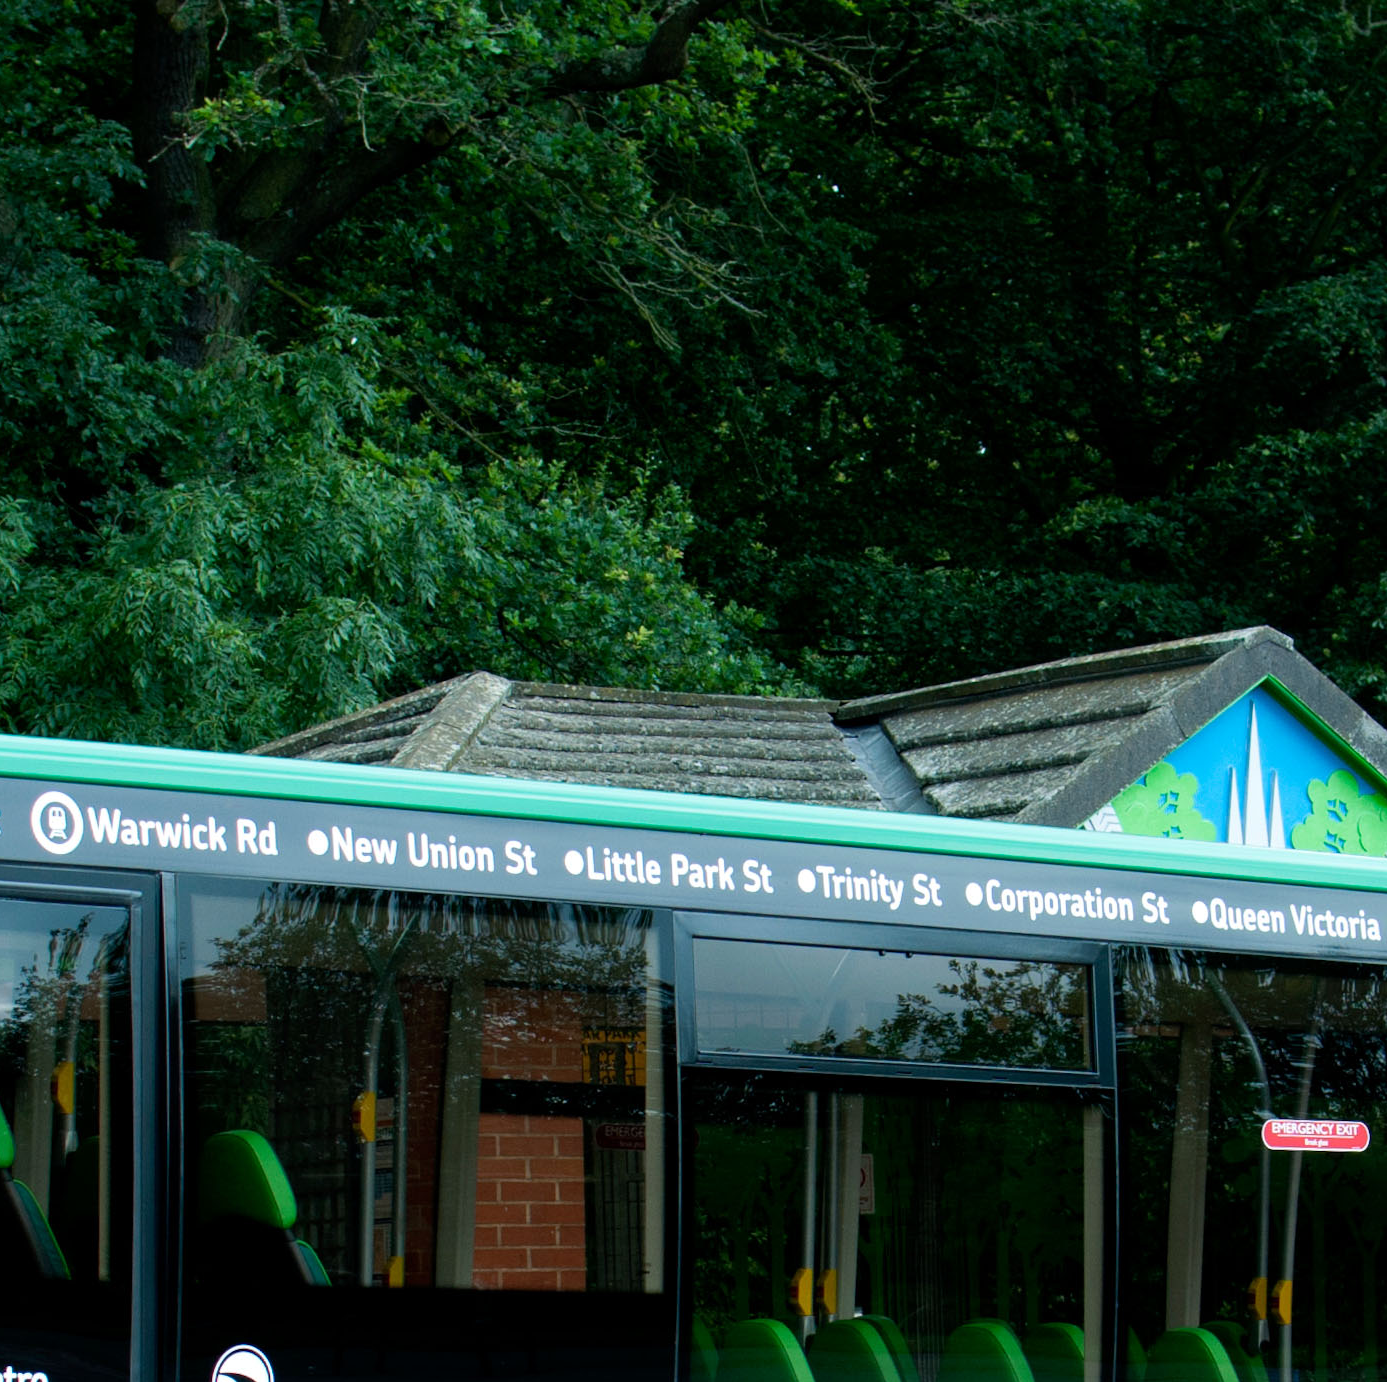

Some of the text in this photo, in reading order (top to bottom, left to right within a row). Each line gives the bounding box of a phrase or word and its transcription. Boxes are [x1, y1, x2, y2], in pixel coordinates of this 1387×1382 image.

[87, 806, 278, 856] Warwick Rd
[331, 825, 537, 876] New Union St
[586, 846, 774, 895] Little Park St
[815, 865, 942, 911] Trinity St
[985, 878, 1170, 926] Corporation St
[1209, 897, 1286, 935] Queen
[1289, 903, 1382, 942] Victoria
[605, 1125, 645, 1137] EMERGE
[1271, 1122, 1359, 1136] EMERGENCY EXIT
